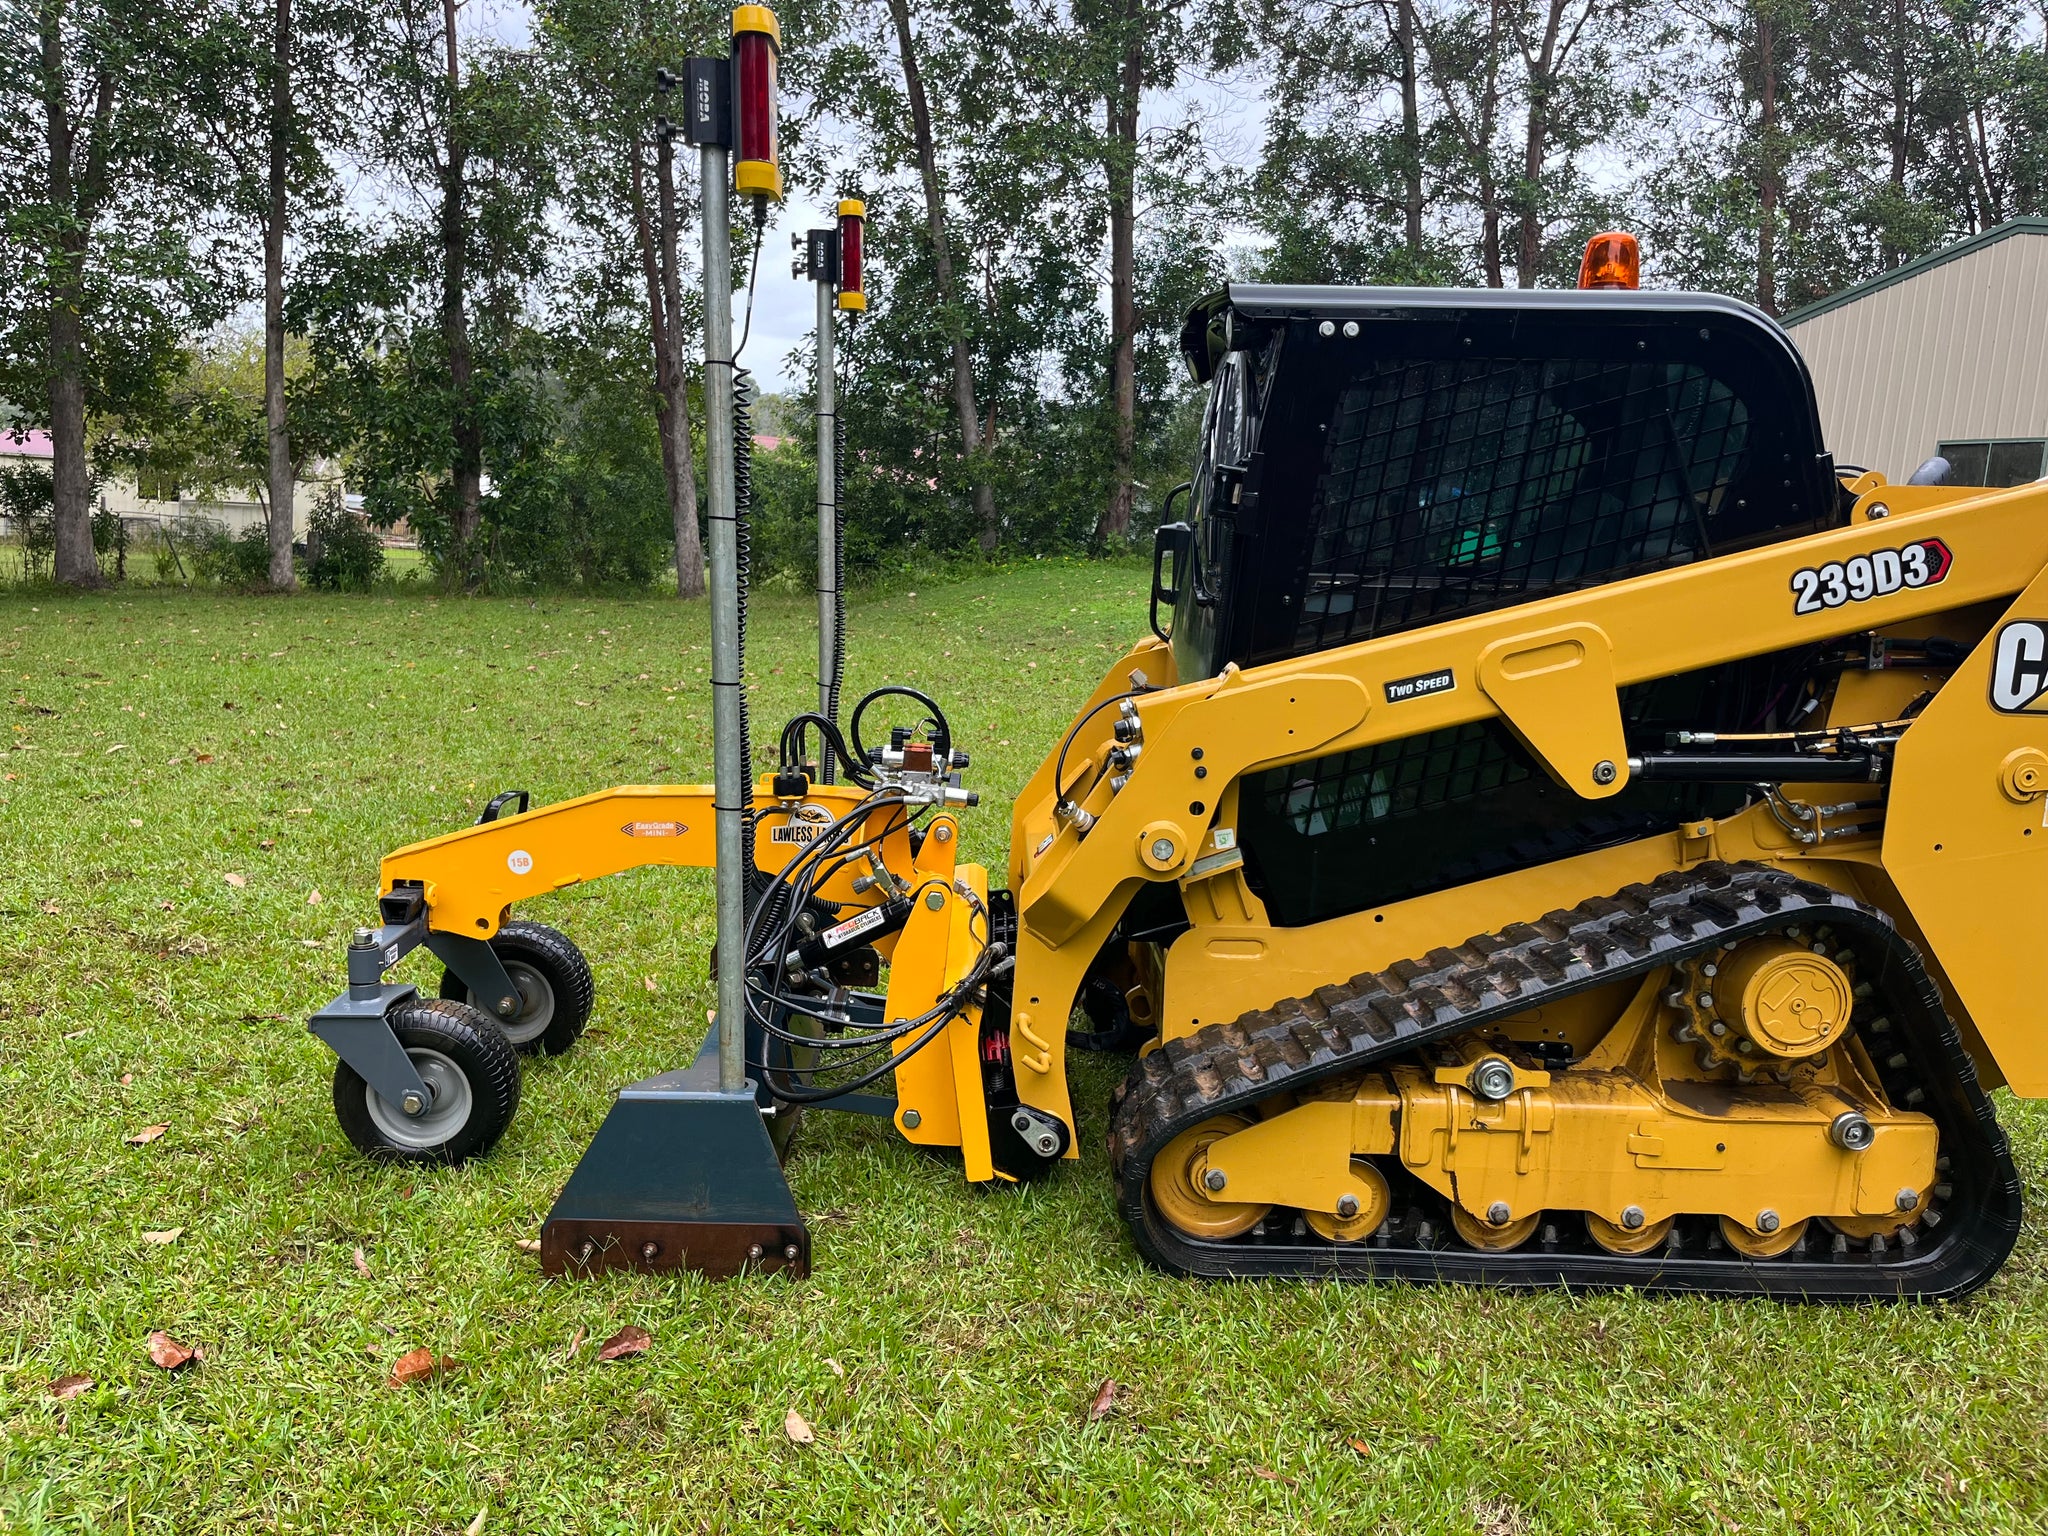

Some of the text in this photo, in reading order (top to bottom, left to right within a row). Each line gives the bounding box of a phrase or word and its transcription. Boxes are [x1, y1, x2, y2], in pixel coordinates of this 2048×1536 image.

[698, 78, 710, 122] MOBA
[1793, 544, 1929, 613] 239D3
[1993, 622, 2048, 710] C
[635, 822, 674, 830] EasyGrade
[773, 826, 813, 843] LAWLESS
[835, 910, 879, 934] REDBACK
